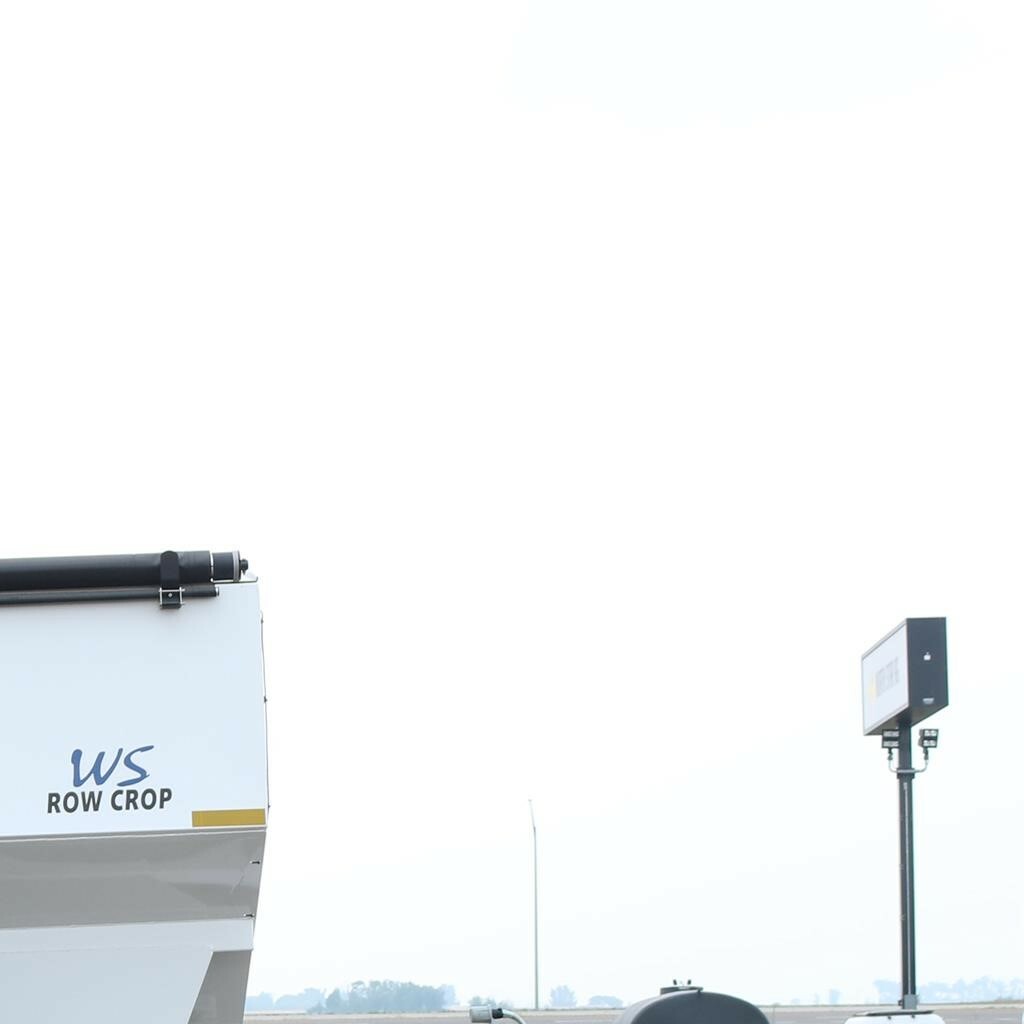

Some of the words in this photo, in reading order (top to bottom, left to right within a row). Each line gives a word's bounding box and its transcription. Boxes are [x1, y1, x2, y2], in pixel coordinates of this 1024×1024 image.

[71, 745, 154, 787] WS
[47, 790, 103, 814] ROW
[111, 788, 173, 811] CROP
